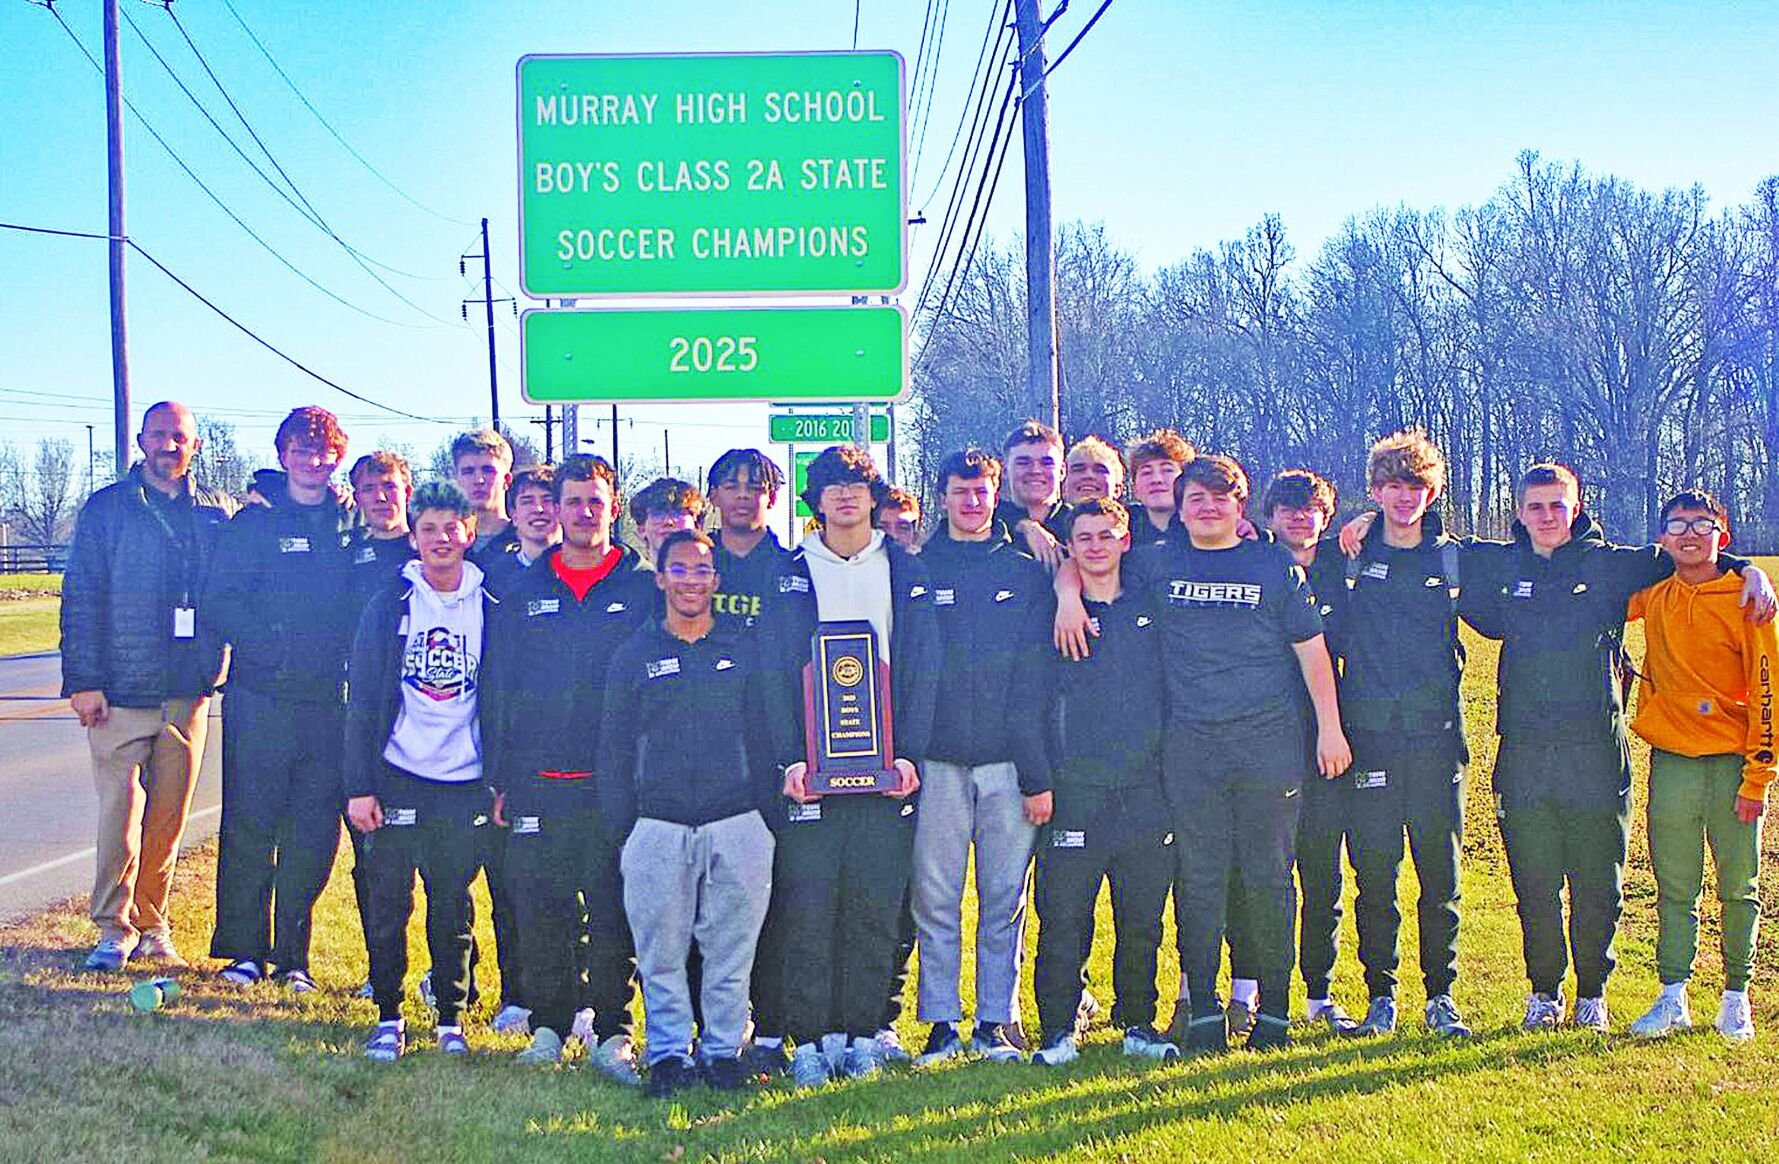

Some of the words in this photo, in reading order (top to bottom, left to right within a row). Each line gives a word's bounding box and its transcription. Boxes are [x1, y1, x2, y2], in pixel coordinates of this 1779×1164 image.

[535, 94, 658, 126] MURRAY
[676, 92, 746, 124] HIGH
[764, 90, 884, 122] SCHOOL
[535, 162, 620, 194] BOY'S
[637, 160, 730, 192] CLASS
[747, 159, 784, 191] 2A
[800, 157, 888, 190] STATE
[557, 229, 675, 261] SOCCER
[692, 226, 869, 258] CHAMPIONS
[669, 336, 759, 374] 2025
[795, 420, 827, 438] 2016
[832, 420, 854, 438] 201
[1169, 580, 1262, 604] TIGERS
[1760, 654, 1774, 748] carhartt
[831, 731, 871, 739] CHAMPIONS
[829, 776, 876, 788] SOCCER
